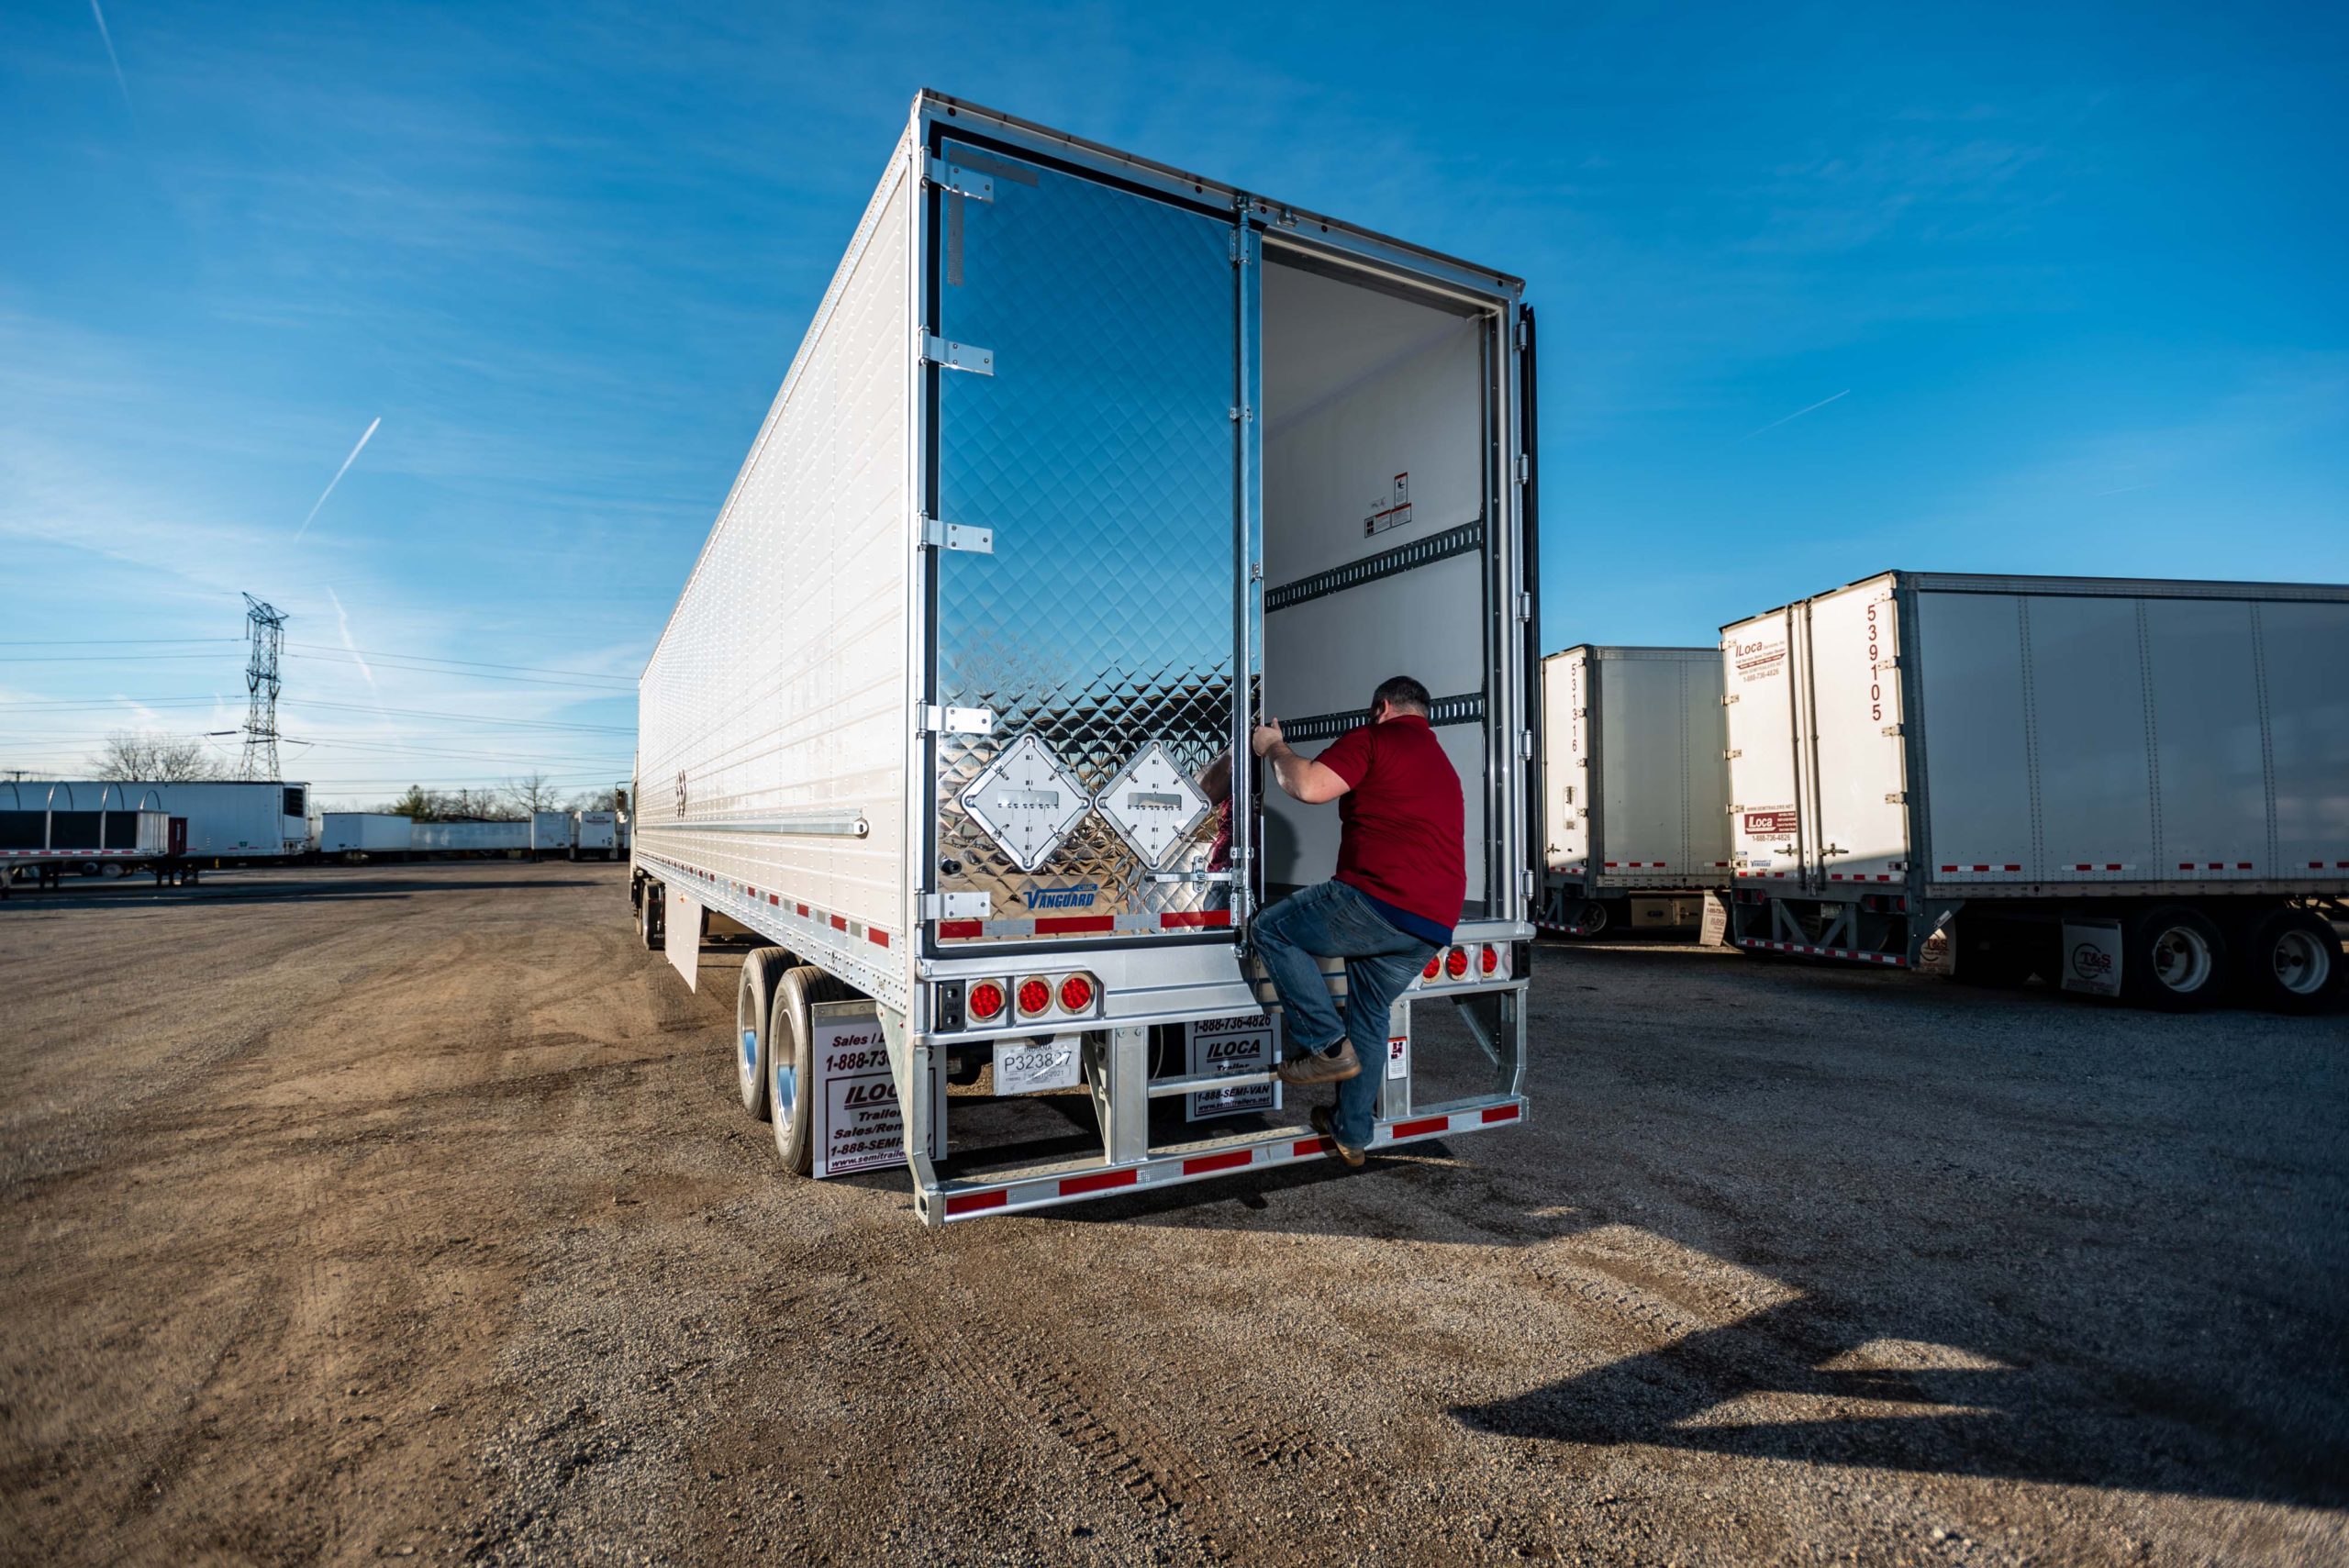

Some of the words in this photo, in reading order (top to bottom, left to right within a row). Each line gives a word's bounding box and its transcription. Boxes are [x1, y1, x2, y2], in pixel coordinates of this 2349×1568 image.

[1735, 641, 1763, 658] ILoca
[1867, 604, 1882, 721] 539105
[1023, 888, 1095, 909] VANGUARD
[2080, 951, 2111, 967] T&S
[1194, 1013, 1272, 1033] 1-888-736-4826
[832, 1034, 868, 1047] Sales
[1207, 1040, 1261, 1058] ILOCA
[827, 1050, 890, 1072] 1-888-73
[845, 1083, 898, 1104] ILOC
[1197, 1084, 1271, 1102] 1-888-SEMI-VAN
[833, 1123, 903, 1140] Sales/Ren
[830, 1138, 904, 1156] 1-888-SEMI-
[831, 1150, 906, 1168] www.semitraile
